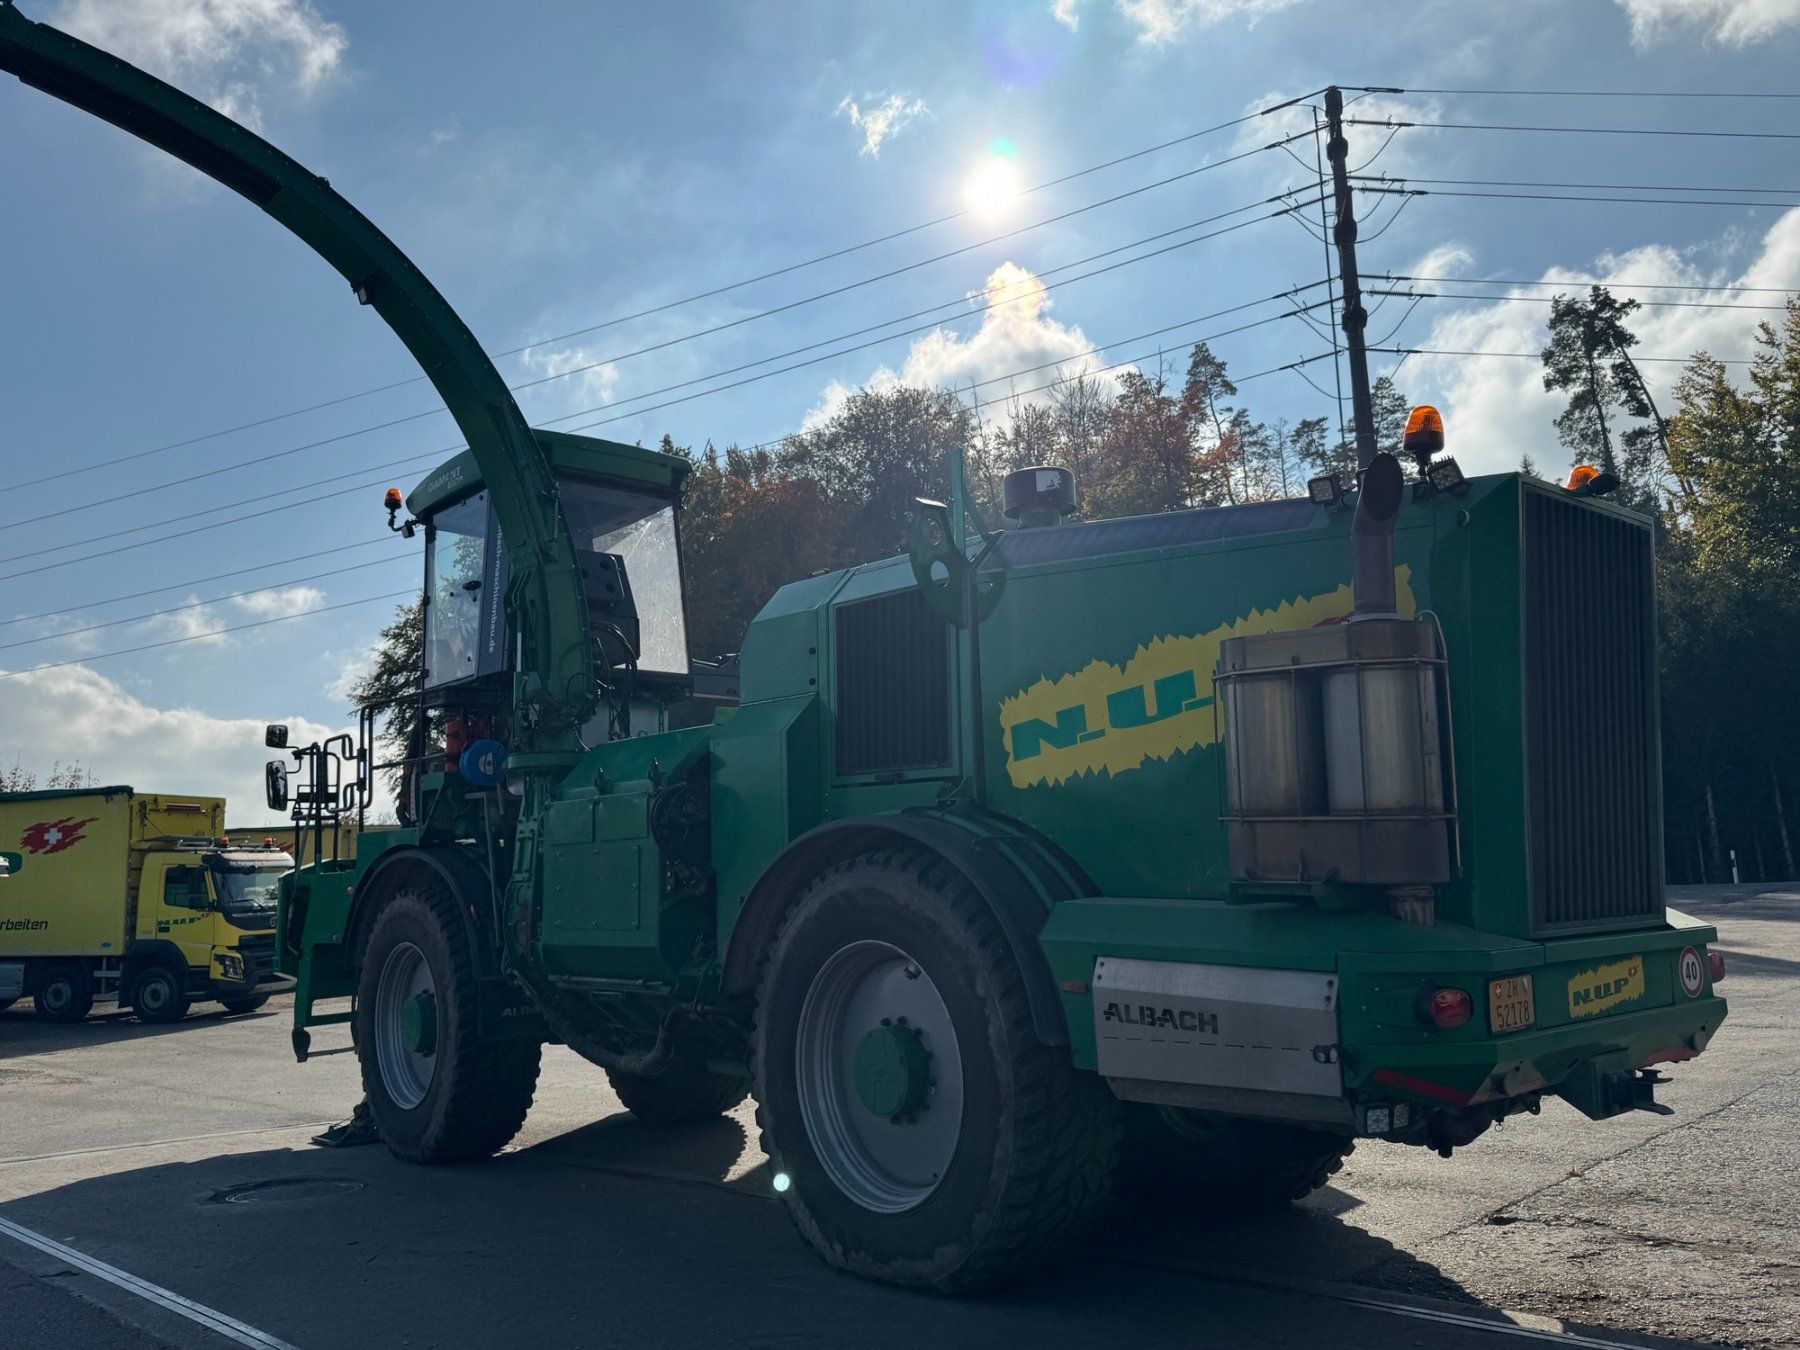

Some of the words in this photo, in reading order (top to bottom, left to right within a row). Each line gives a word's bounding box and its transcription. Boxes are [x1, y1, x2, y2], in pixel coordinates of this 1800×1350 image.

[1010, 664, 1225, 762] N.U.
[1685, 961, 1698, 981] 40
[1506, 980, 1519, 998] ZH
[1103, 1002, 1219, 1034] ALBACH
[1497, 1000, 1530, 1028] 52178
